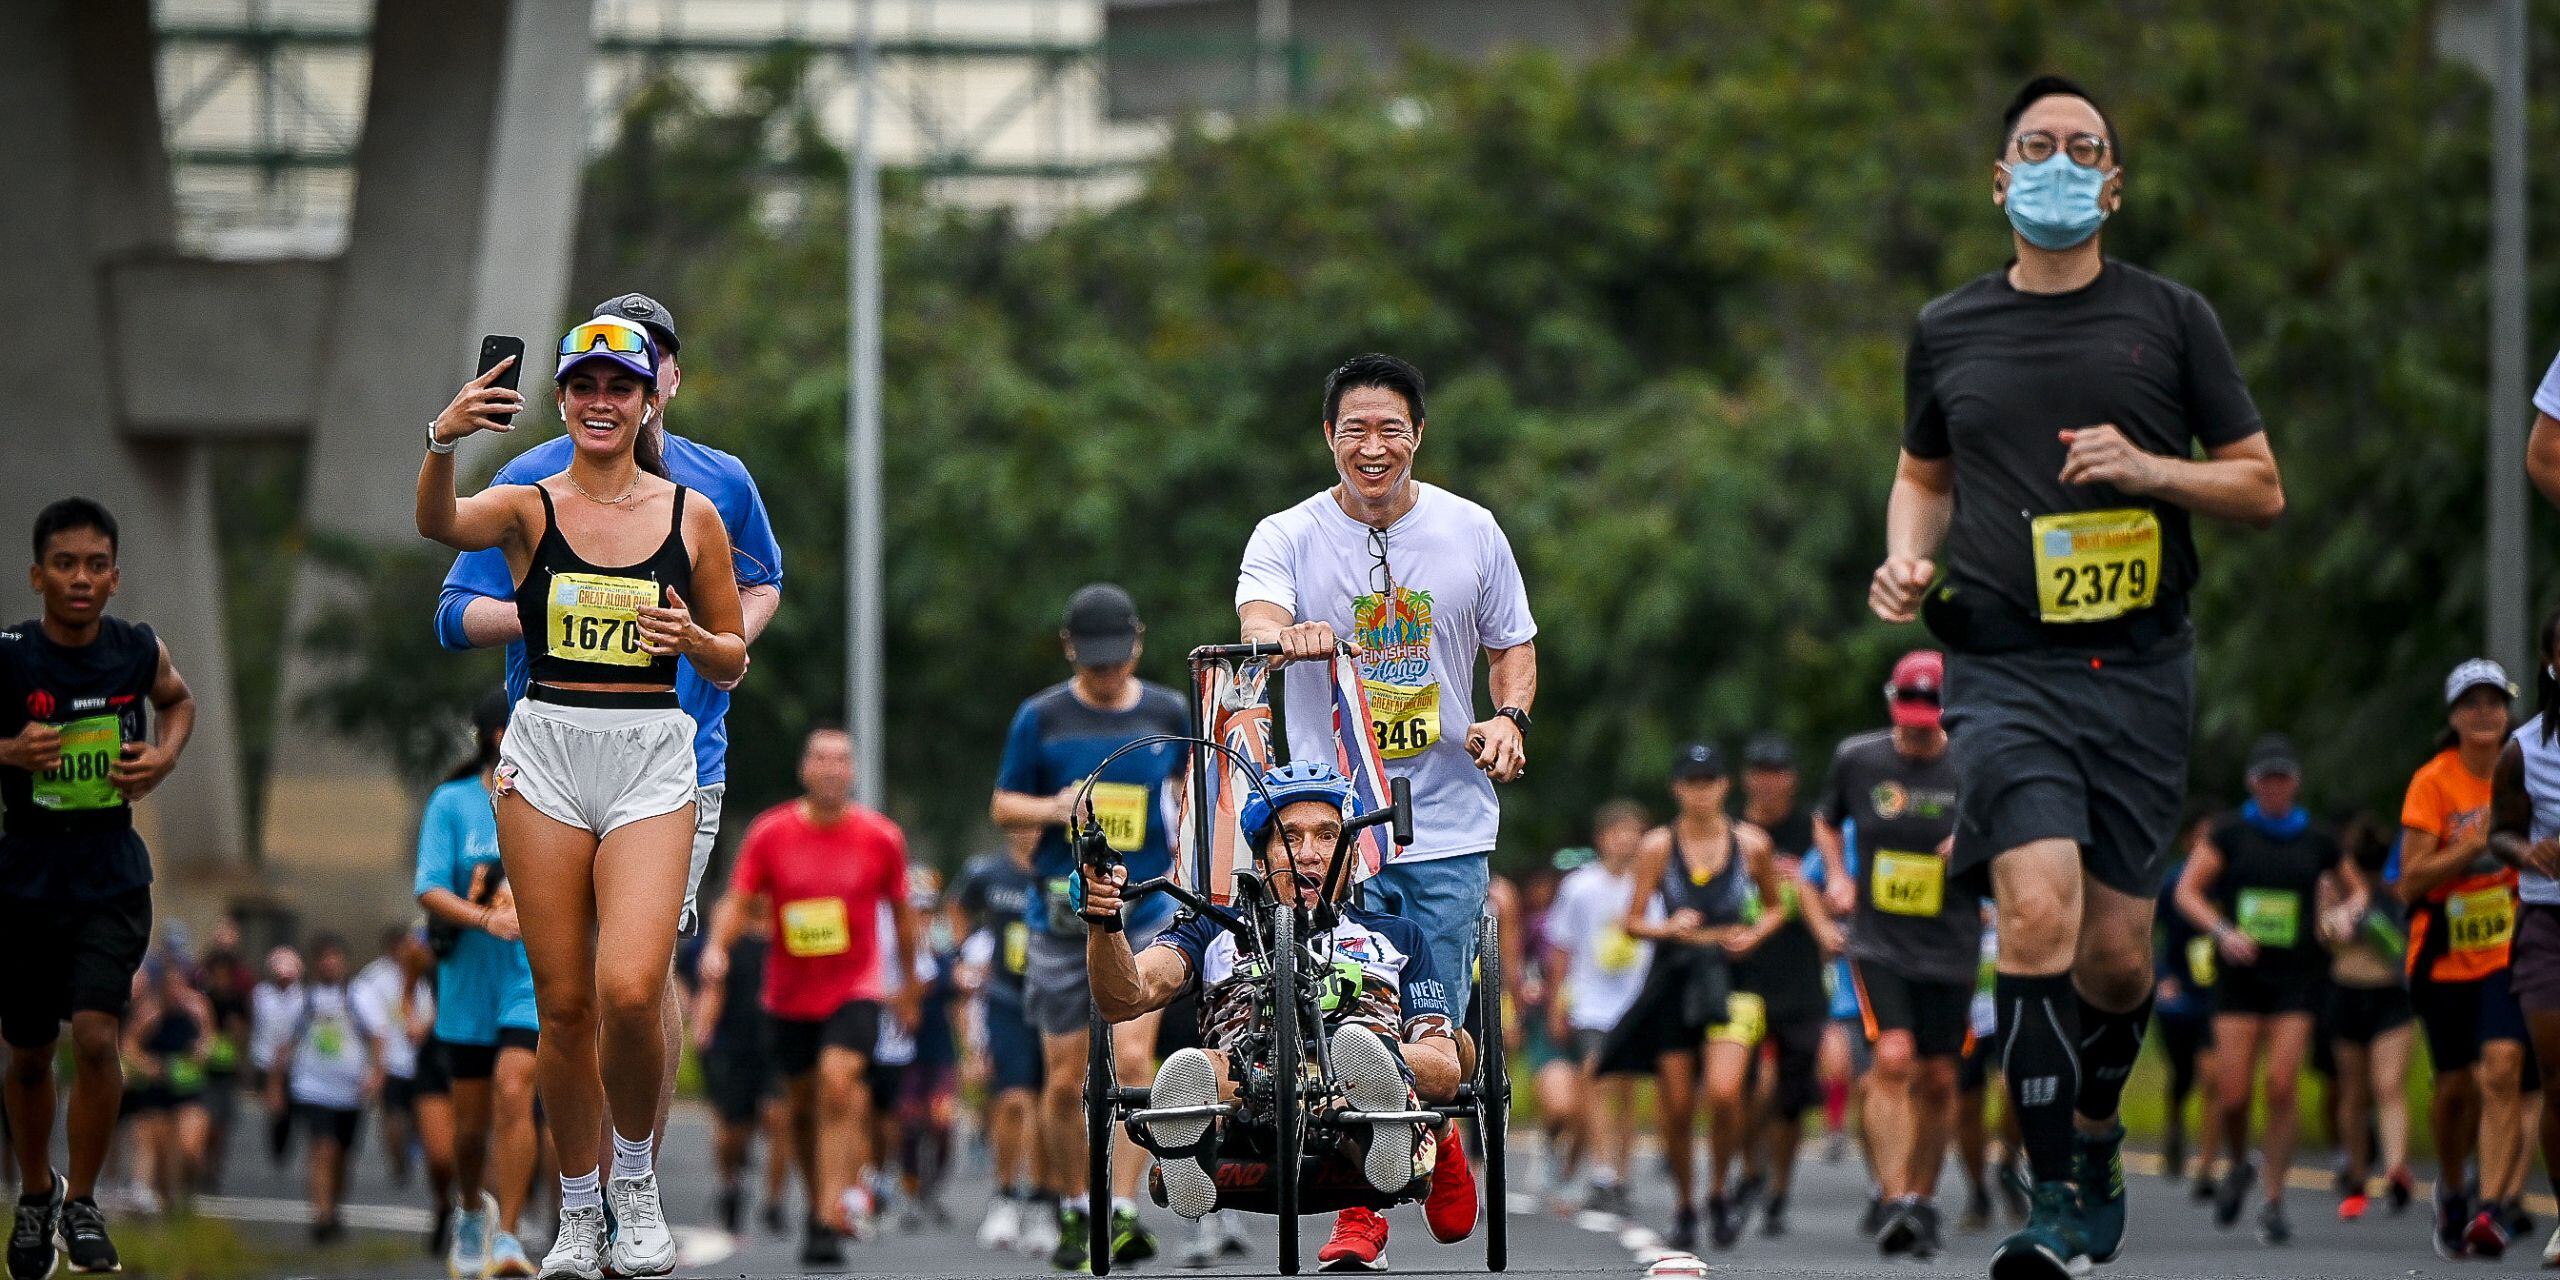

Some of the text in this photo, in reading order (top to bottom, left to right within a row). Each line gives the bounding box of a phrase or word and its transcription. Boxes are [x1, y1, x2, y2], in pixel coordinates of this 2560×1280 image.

[2053, 558, 2147, 608] 2379
[579, 589, 605, 607] GREAT
[605, 592, 631, 609] ALOHA
[561, 613, 642, 655] 1670
[1361, 645, 1431, 664] FINISHER
[1360, 658, 1430, 685] Aloha
